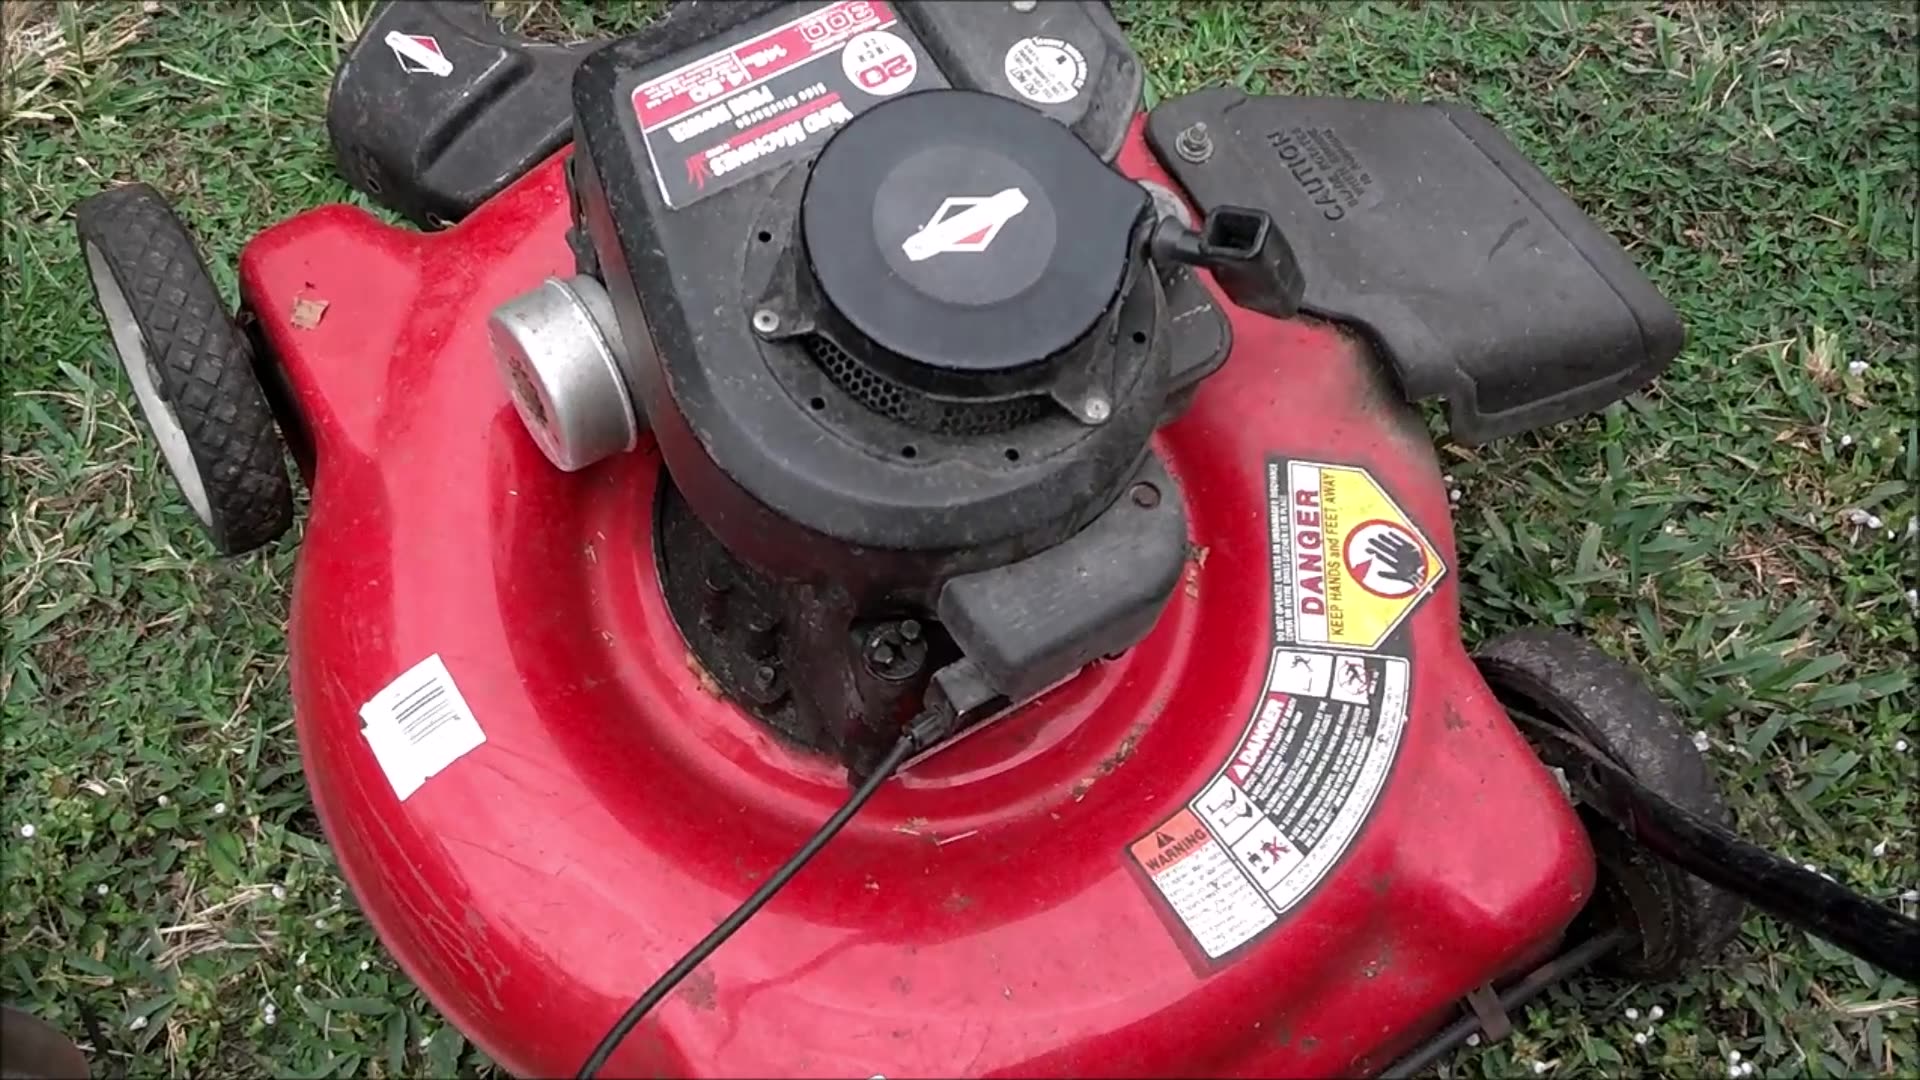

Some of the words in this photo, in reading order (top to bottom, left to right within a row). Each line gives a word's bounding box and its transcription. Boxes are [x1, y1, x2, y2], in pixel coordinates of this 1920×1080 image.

[797, 0, 875, 44] 300
[854, 52, 913, 91] 20
[1267, 131, 1345, 222] CAUTION
[1322, 472, 1336, 504] AWAY
[1324, 506, 1338, 535] FEET
[1295, 488, 1325, 616] DANGER
[1327, 537, 1339, 558] and
[1327, 561, 1342, 601] HANDS
[1329, 604, 1344, 635] KEEP
[1238, 699, 1285, 766] DANGER
[1145, 827, 1207, 871] WARNING
